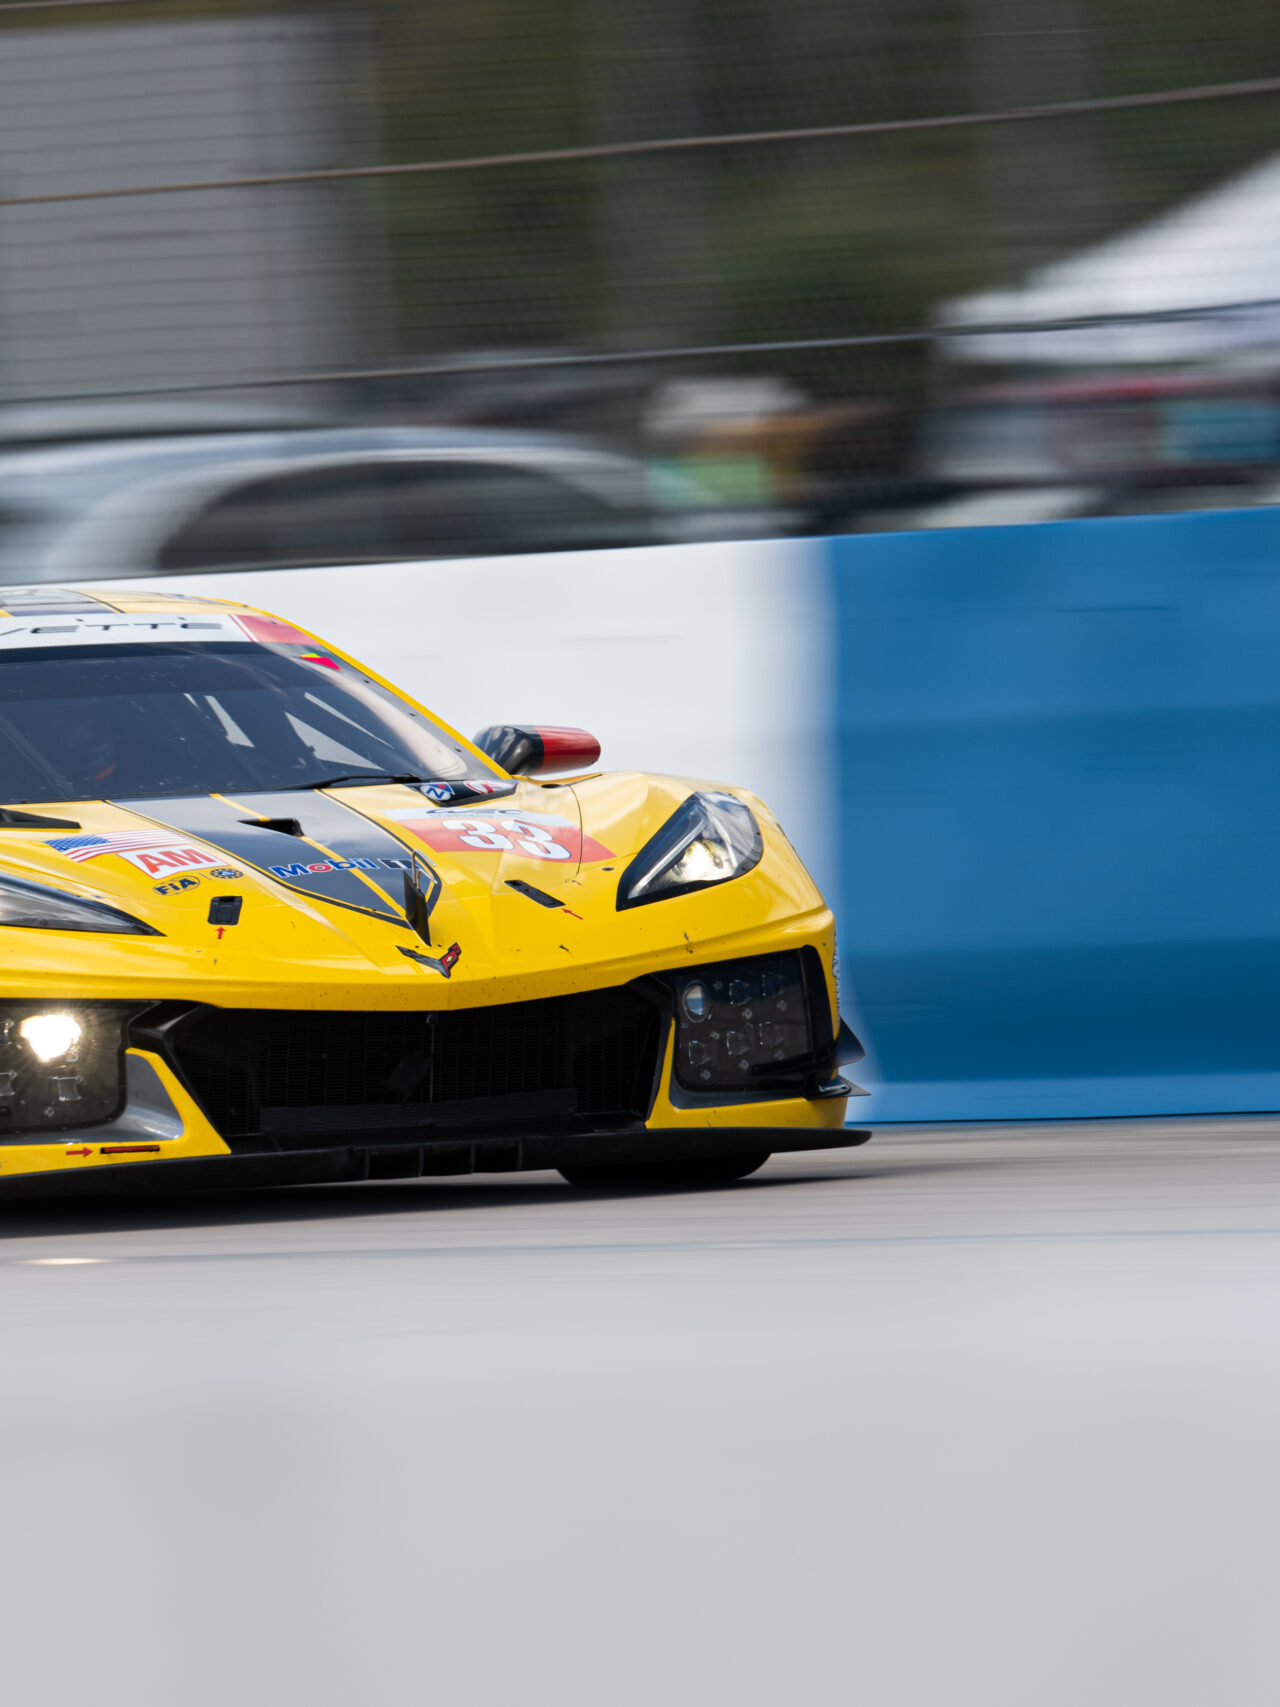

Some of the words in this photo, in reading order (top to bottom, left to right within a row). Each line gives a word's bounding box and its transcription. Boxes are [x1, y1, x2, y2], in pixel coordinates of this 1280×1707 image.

[442, 819, 572, 860] 33
[135, 848, 217, 874] AM
[268, 857, 380, 878] Mobil
[153, 878, 197, 895] FIA
